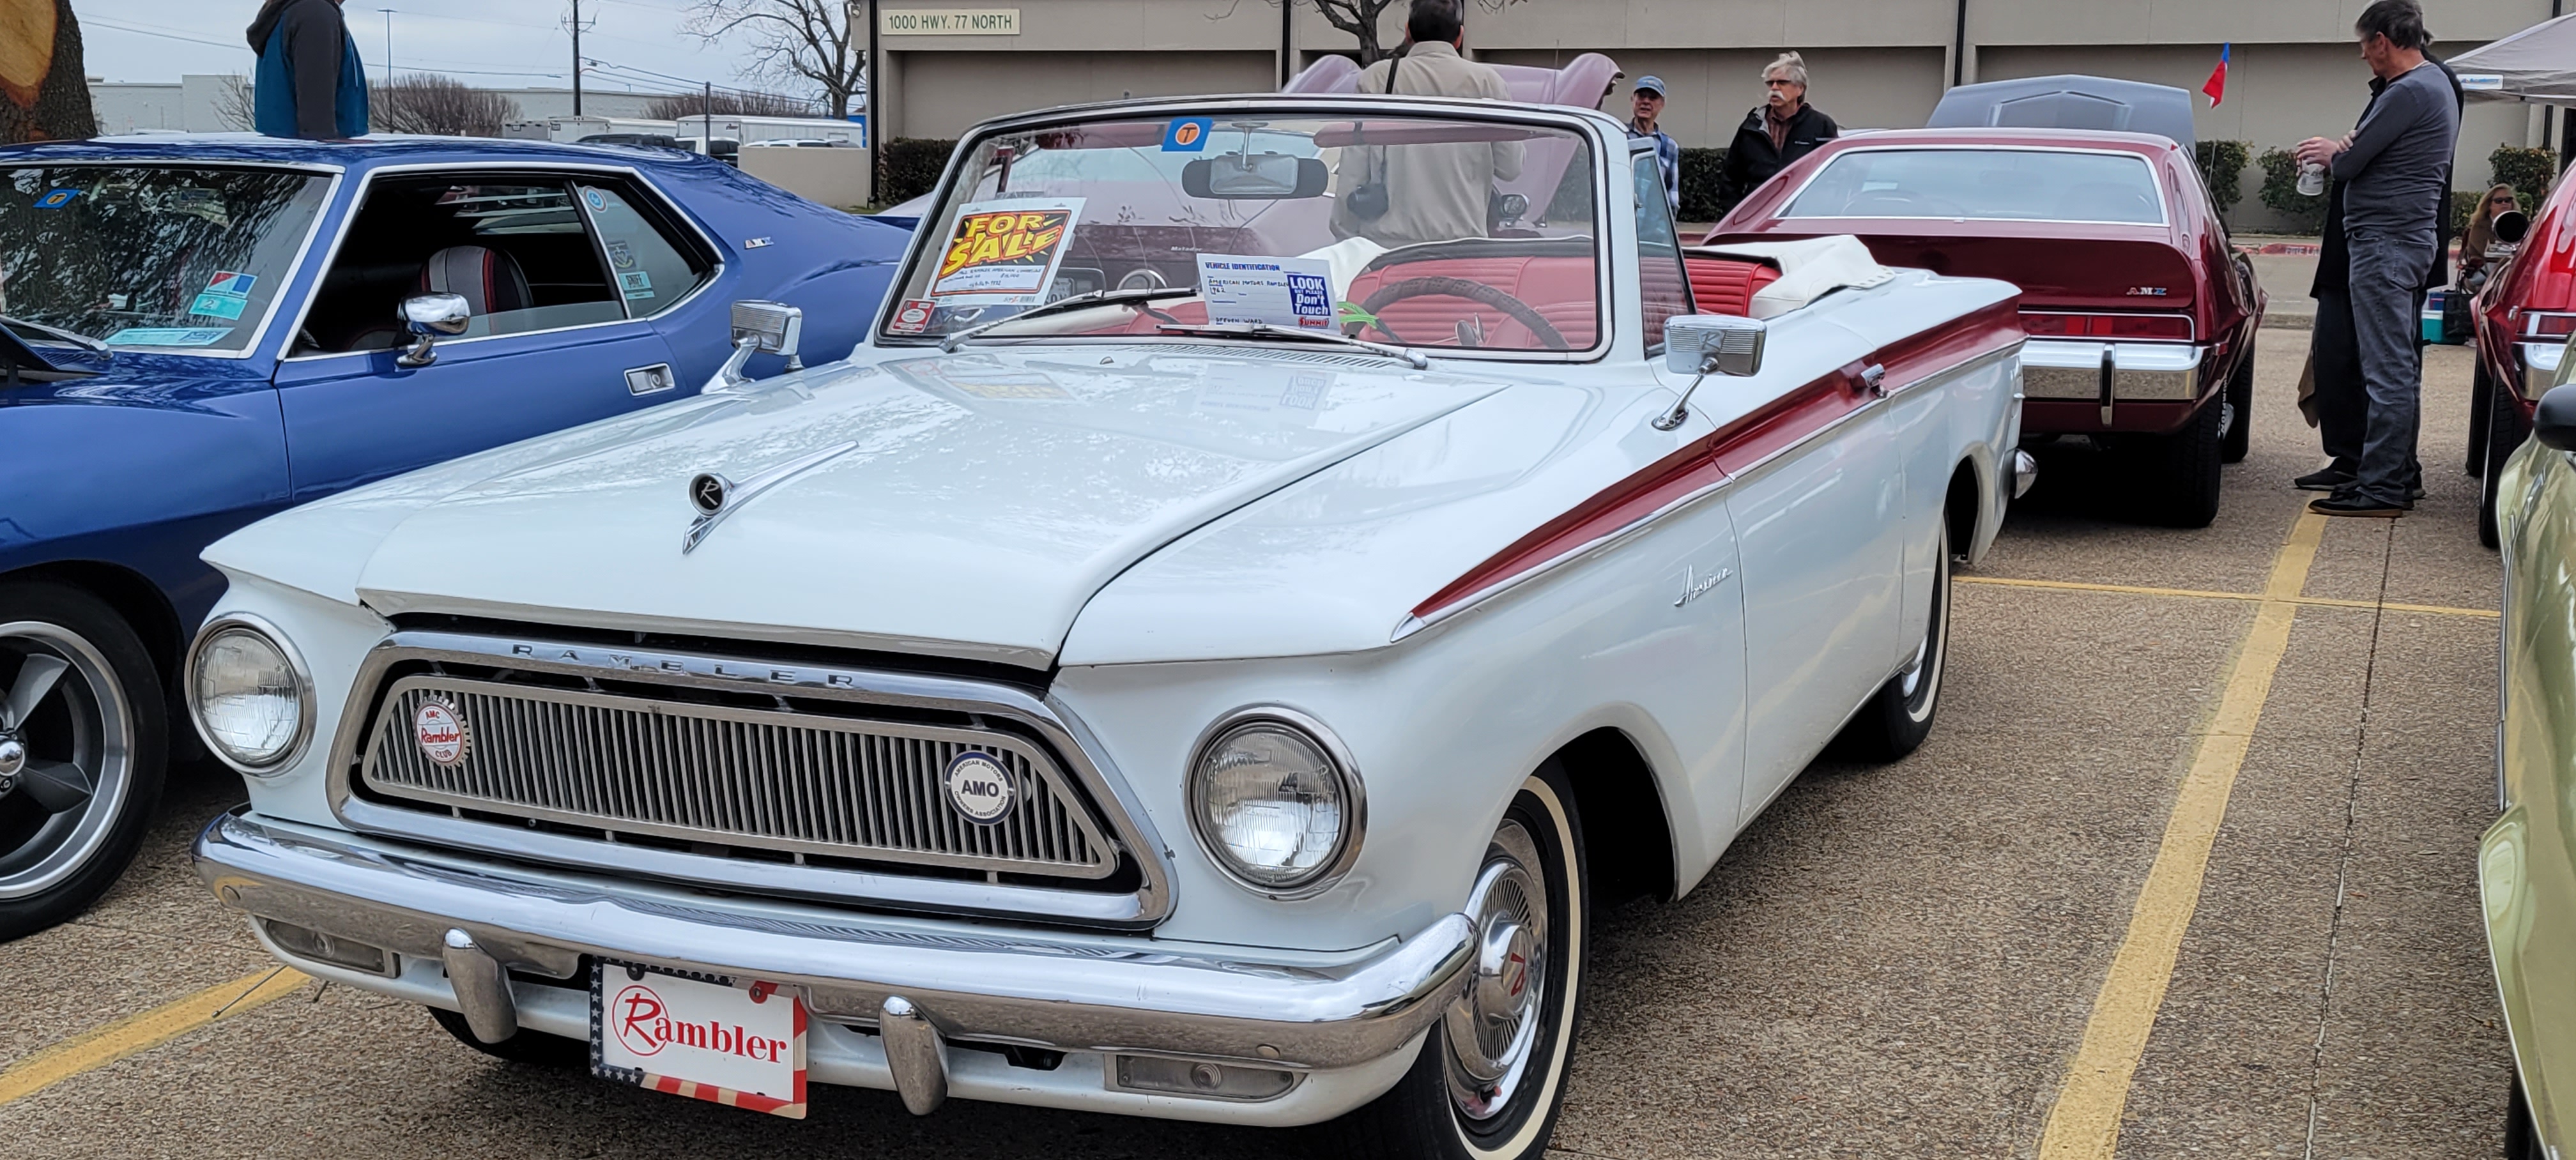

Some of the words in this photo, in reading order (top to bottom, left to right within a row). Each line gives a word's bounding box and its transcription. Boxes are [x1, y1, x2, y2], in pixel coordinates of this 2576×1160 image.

[889, 15, 917, 29] 1000
[921, 15, 951, 29] HWY.
[954, 15, 967, 29] 77
[972, 15, 1012, 29] NORTH
[1181, 126, 1197, 143] T
[965, 213, 1045, 238] FOR
[941, 226, 1061, 275] SALE
[1231, 263, 1281, 271] IDENTIFICATION
[1289, 277, 1324, 291] LOOK
[1296, 293, 1325, 305] Don't
[1294, 303, 1329, 315] Touch
[700, 480, 720, 506] R
[511, 643, 855, 687] RAMBLER
[425, 710, 440, 720] AMC
[421, 726, 461, 744] Rambler
[434, 749, 453, 758] CLUB
[954, 759, 980, 777] AMERICAN
[981, 761, 1004, 782] MOTORS
[961, 779, 1000, 798] AMO
[954, 790, 974, 814] OWNERS
[974, 795, 1006, 816] ASSOCIATION
[623, 992, 788, 1064] Rambler
